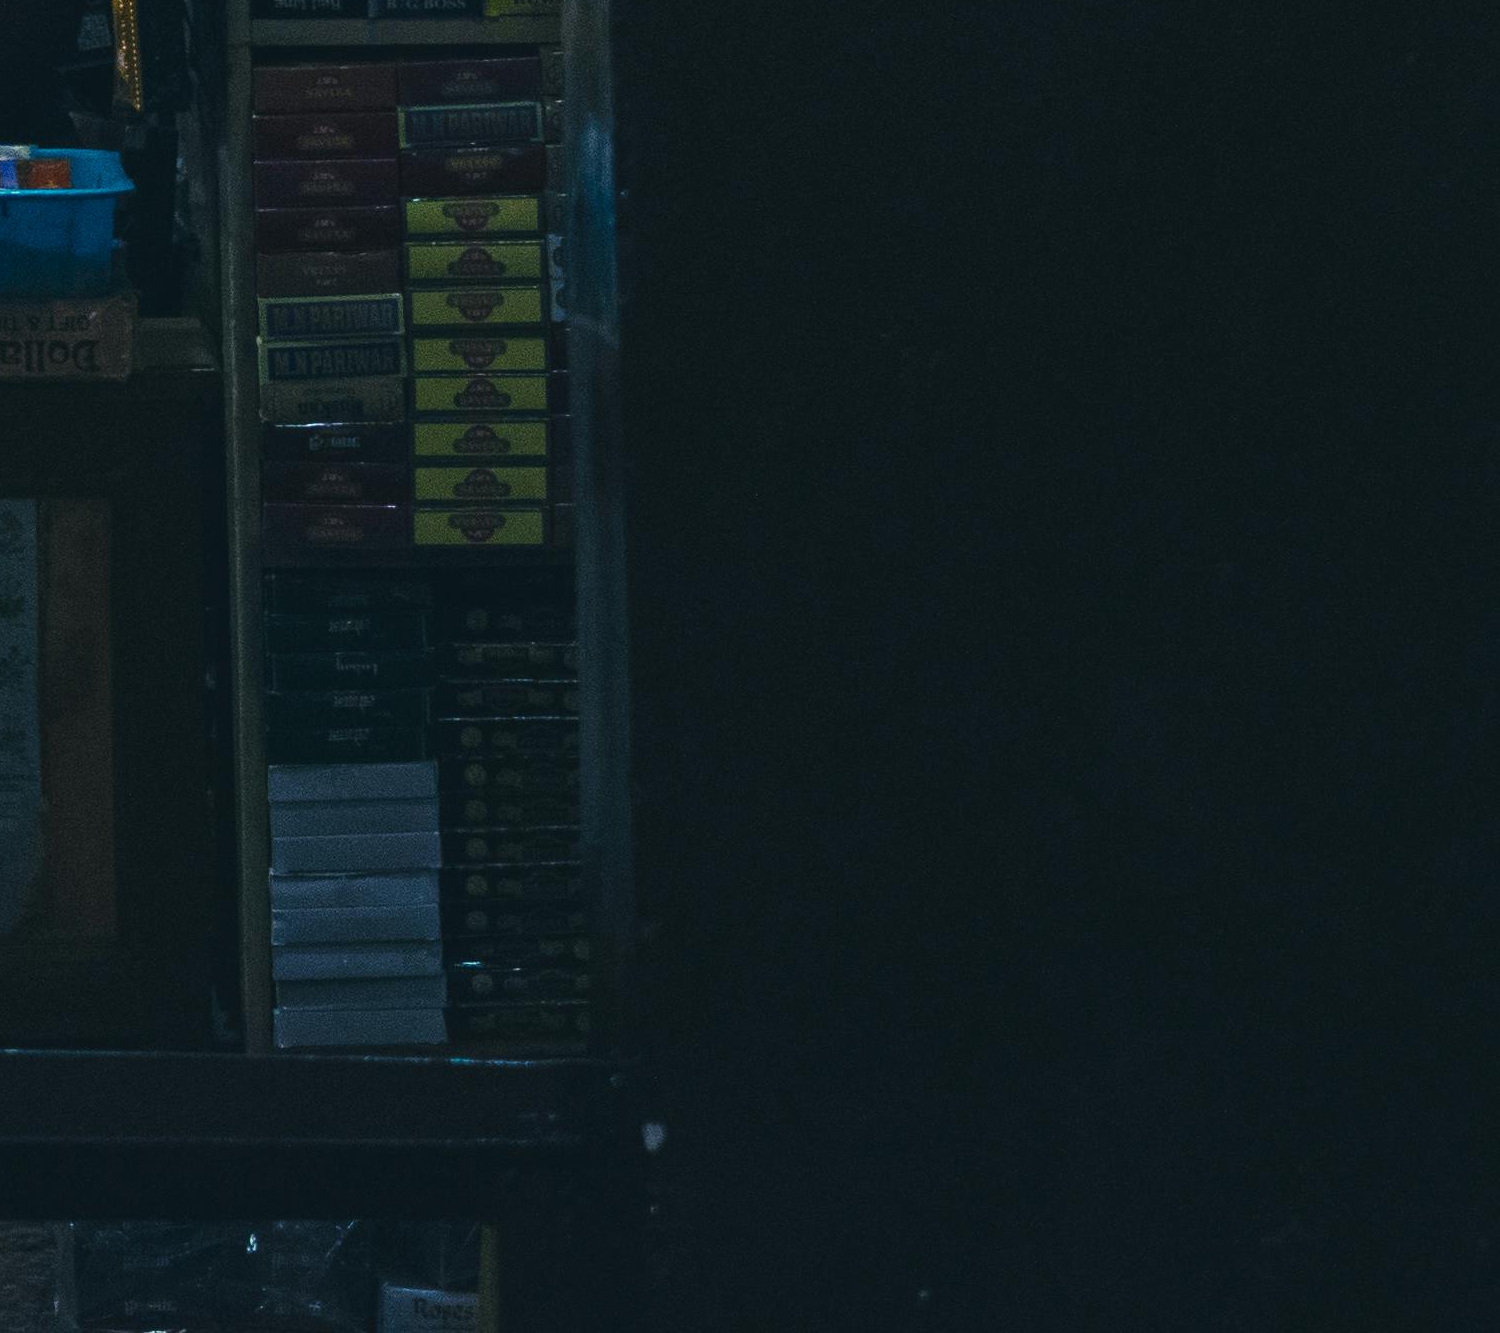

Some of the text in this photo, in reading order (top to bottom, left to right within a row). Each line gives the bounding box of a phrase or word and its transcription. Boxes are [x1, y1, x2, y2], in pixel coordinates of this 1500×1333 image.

[50, 314, 89, 332] GIFT
[311, 303, 394, 329] PARIWAR
[311, 348, 394, 374] PARIWAR
